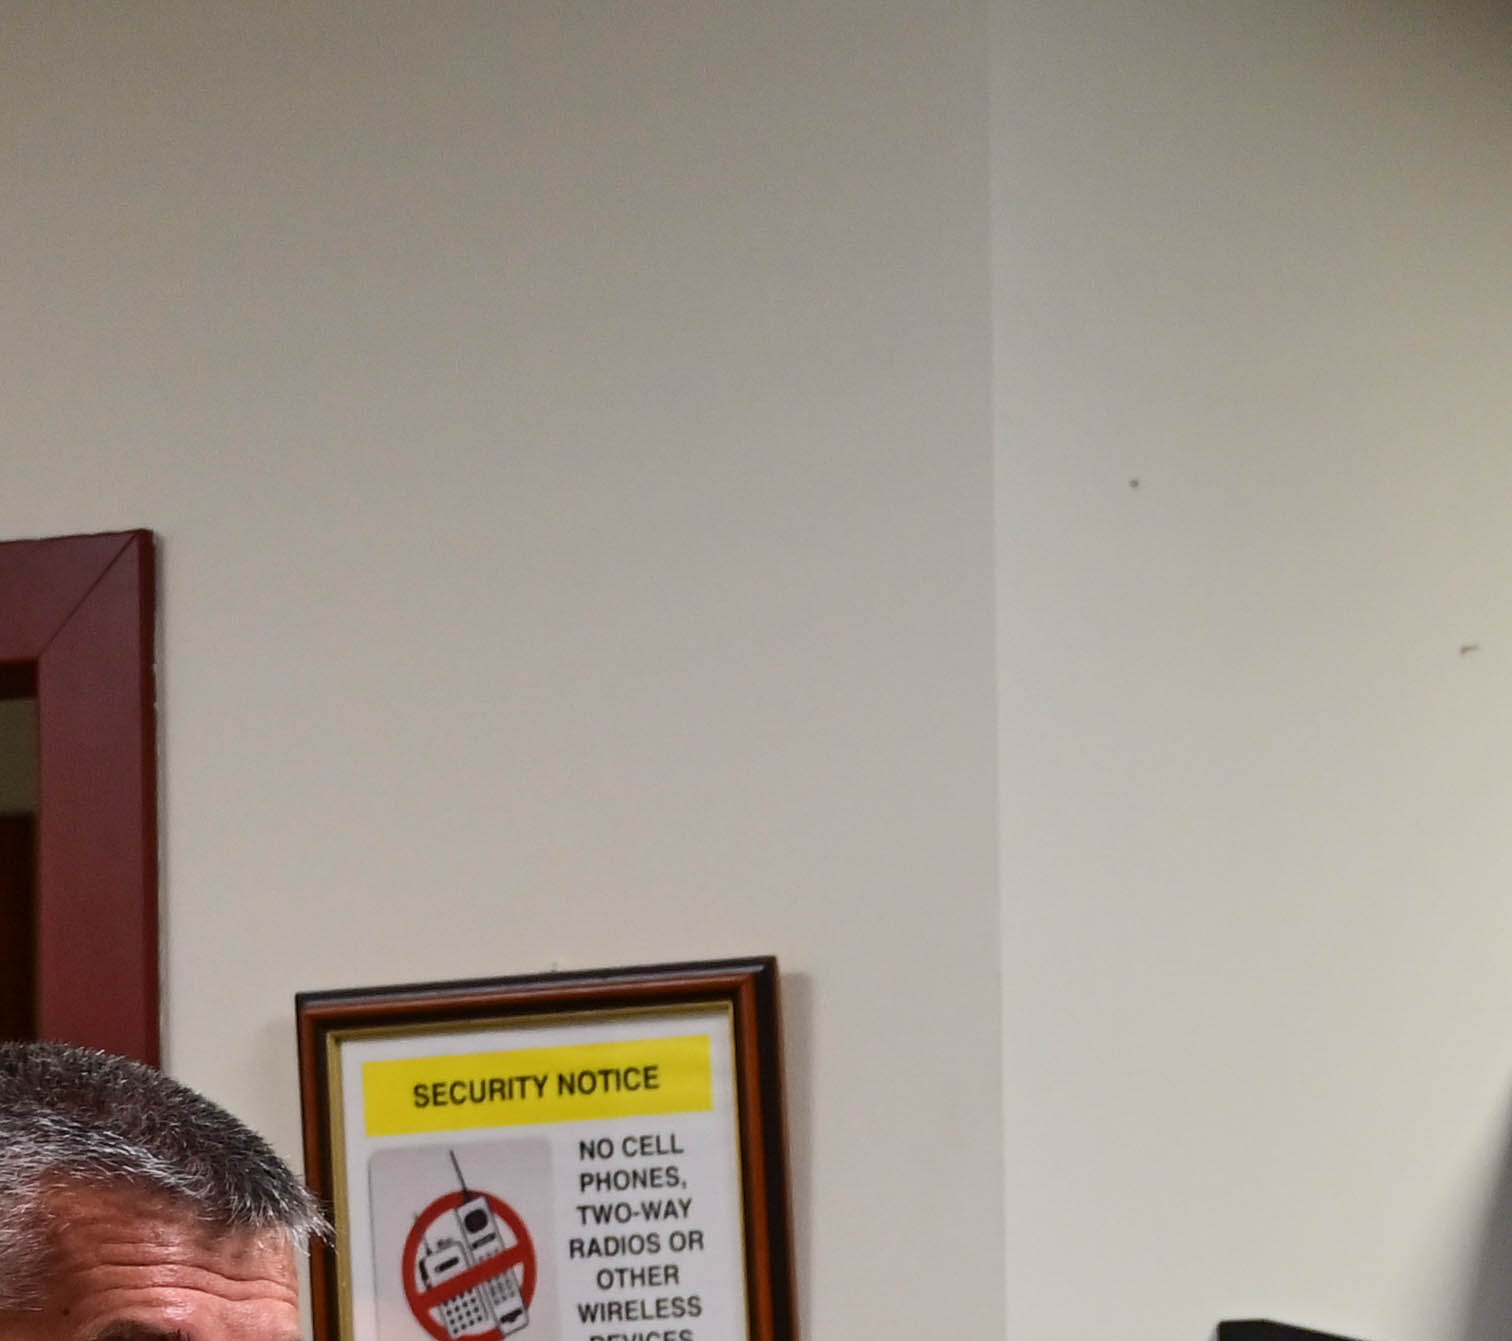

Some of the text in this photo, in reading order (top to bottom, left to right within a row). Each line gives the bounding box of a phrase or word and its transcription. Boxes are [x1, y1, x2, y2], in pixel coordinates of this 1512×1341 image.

[412, 1064, 660, 1108] SECURITY NOTICE
[579, 1134, 684, 1161] NO CELL
[579, 1168, 688, 1193] PHONES,
[576, 1198, 692, 1225] TWO-WAY
[568, 1230, 704, 1259] RADIOS OR
[595, 1264, 680, 1290] OTHER
[577, 1297, 703, 1323] WIRELESS
